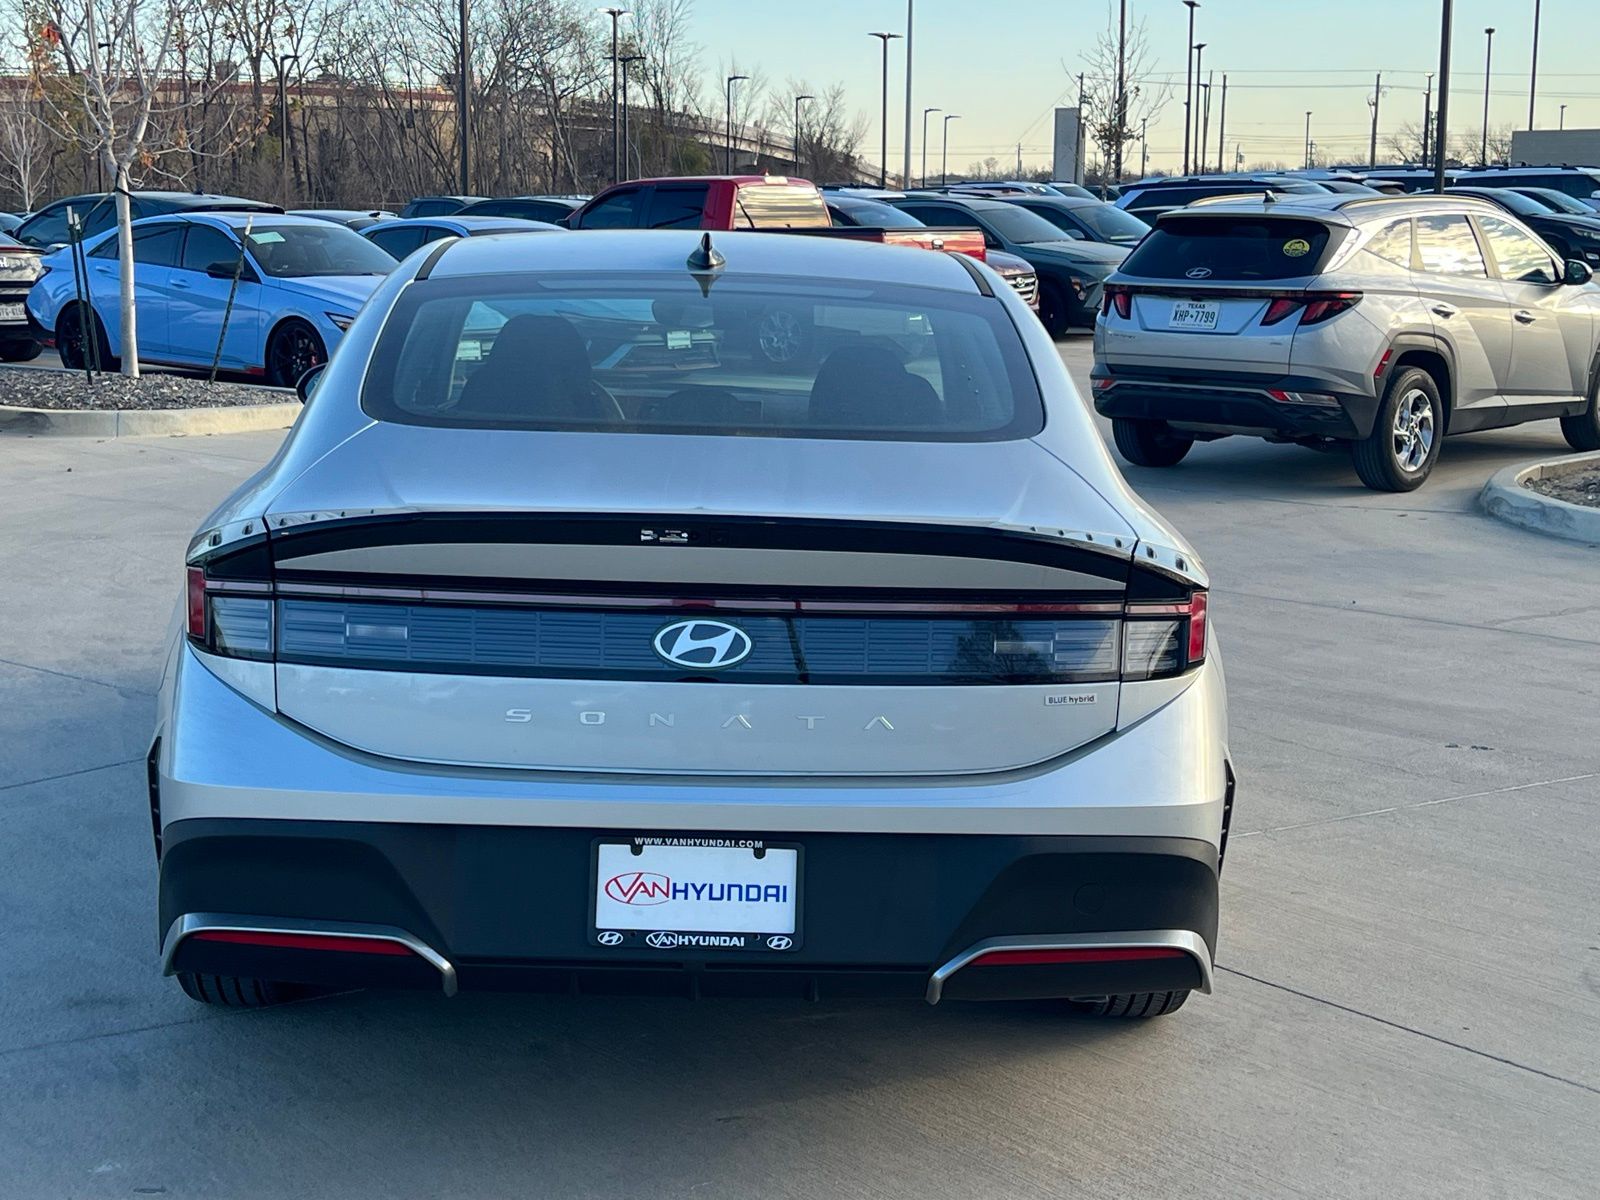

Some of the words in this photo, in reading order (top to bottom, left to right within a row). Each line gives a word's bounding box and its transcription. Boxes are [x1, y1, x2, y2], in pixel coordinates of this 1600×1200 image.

[1048, 696, 1067, 704] BLUE
[1068, 694, 1095, 704] hybrid
[504, 707, 895, 731] SONATA
[634, 837, 763, 849] WWW.VANHYUNDAI.COM
